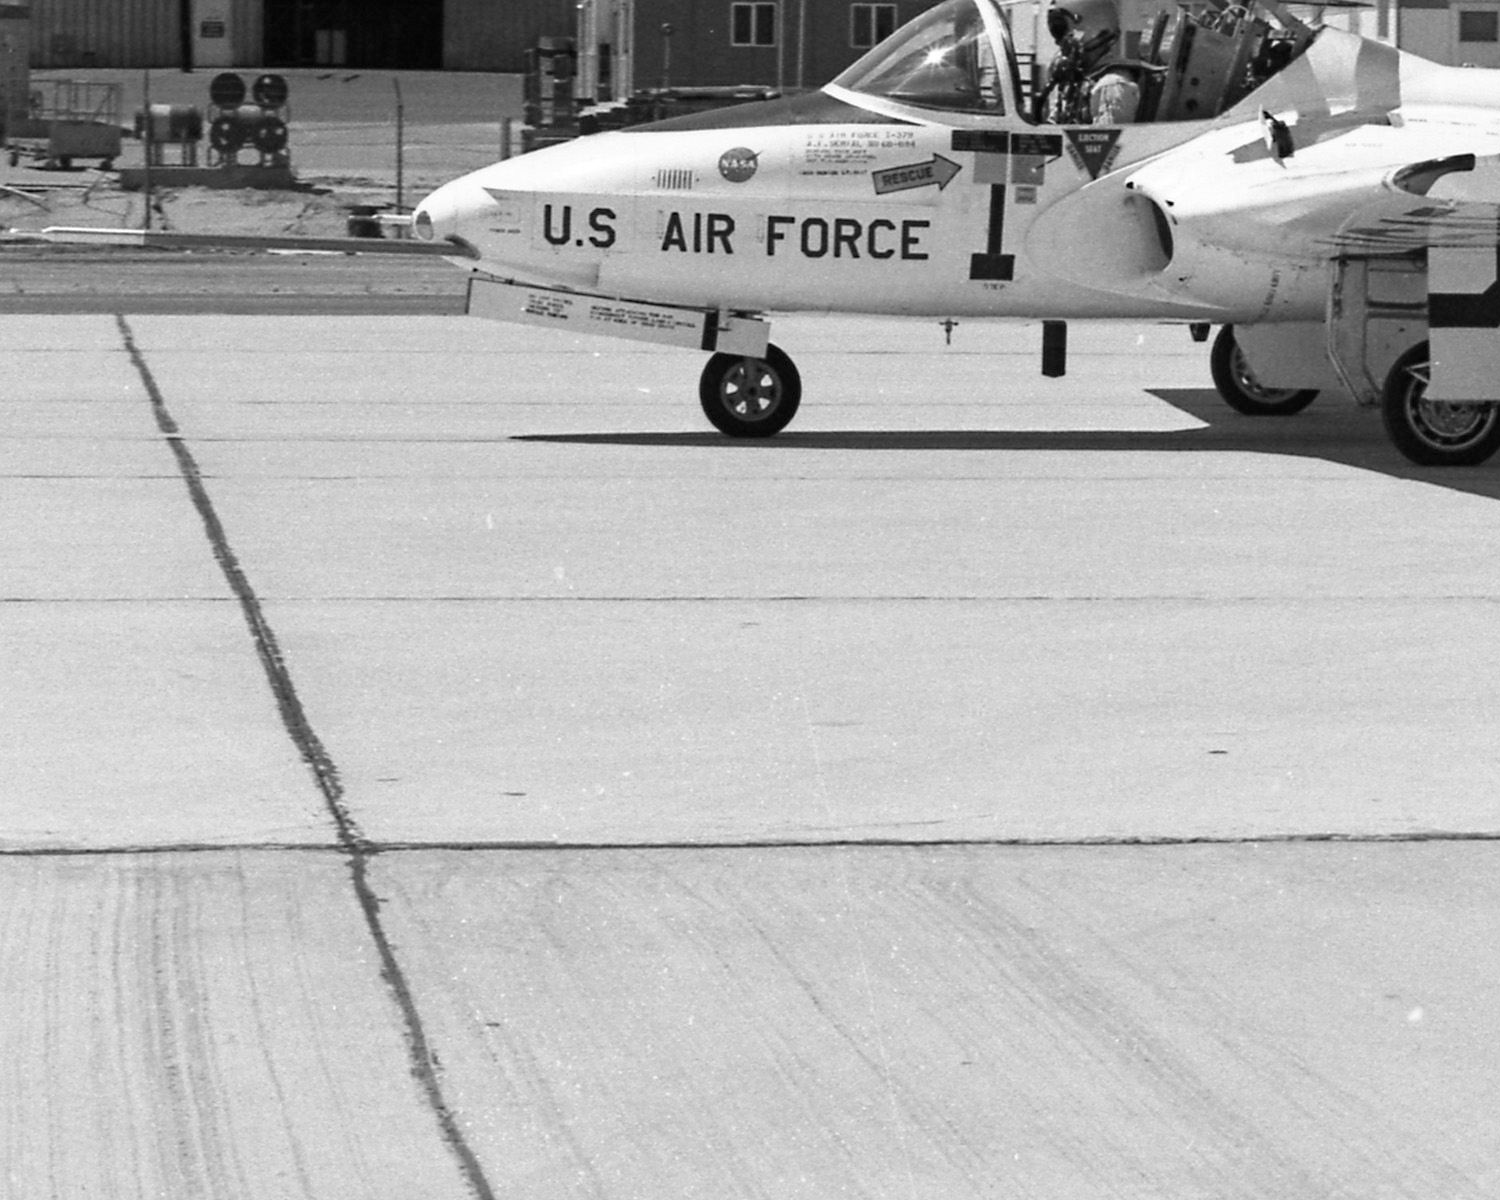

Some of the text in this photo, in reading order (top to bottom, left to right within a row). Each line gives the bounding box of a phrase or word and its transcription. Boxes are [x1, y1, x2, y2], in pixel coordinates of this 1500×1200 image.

[721, 158, 756, 169] NASA
[882, 166, 934, 187] RESCUE
[661, 211, 736, 255] AIR
[766, 215, 931, 261] FORCE
